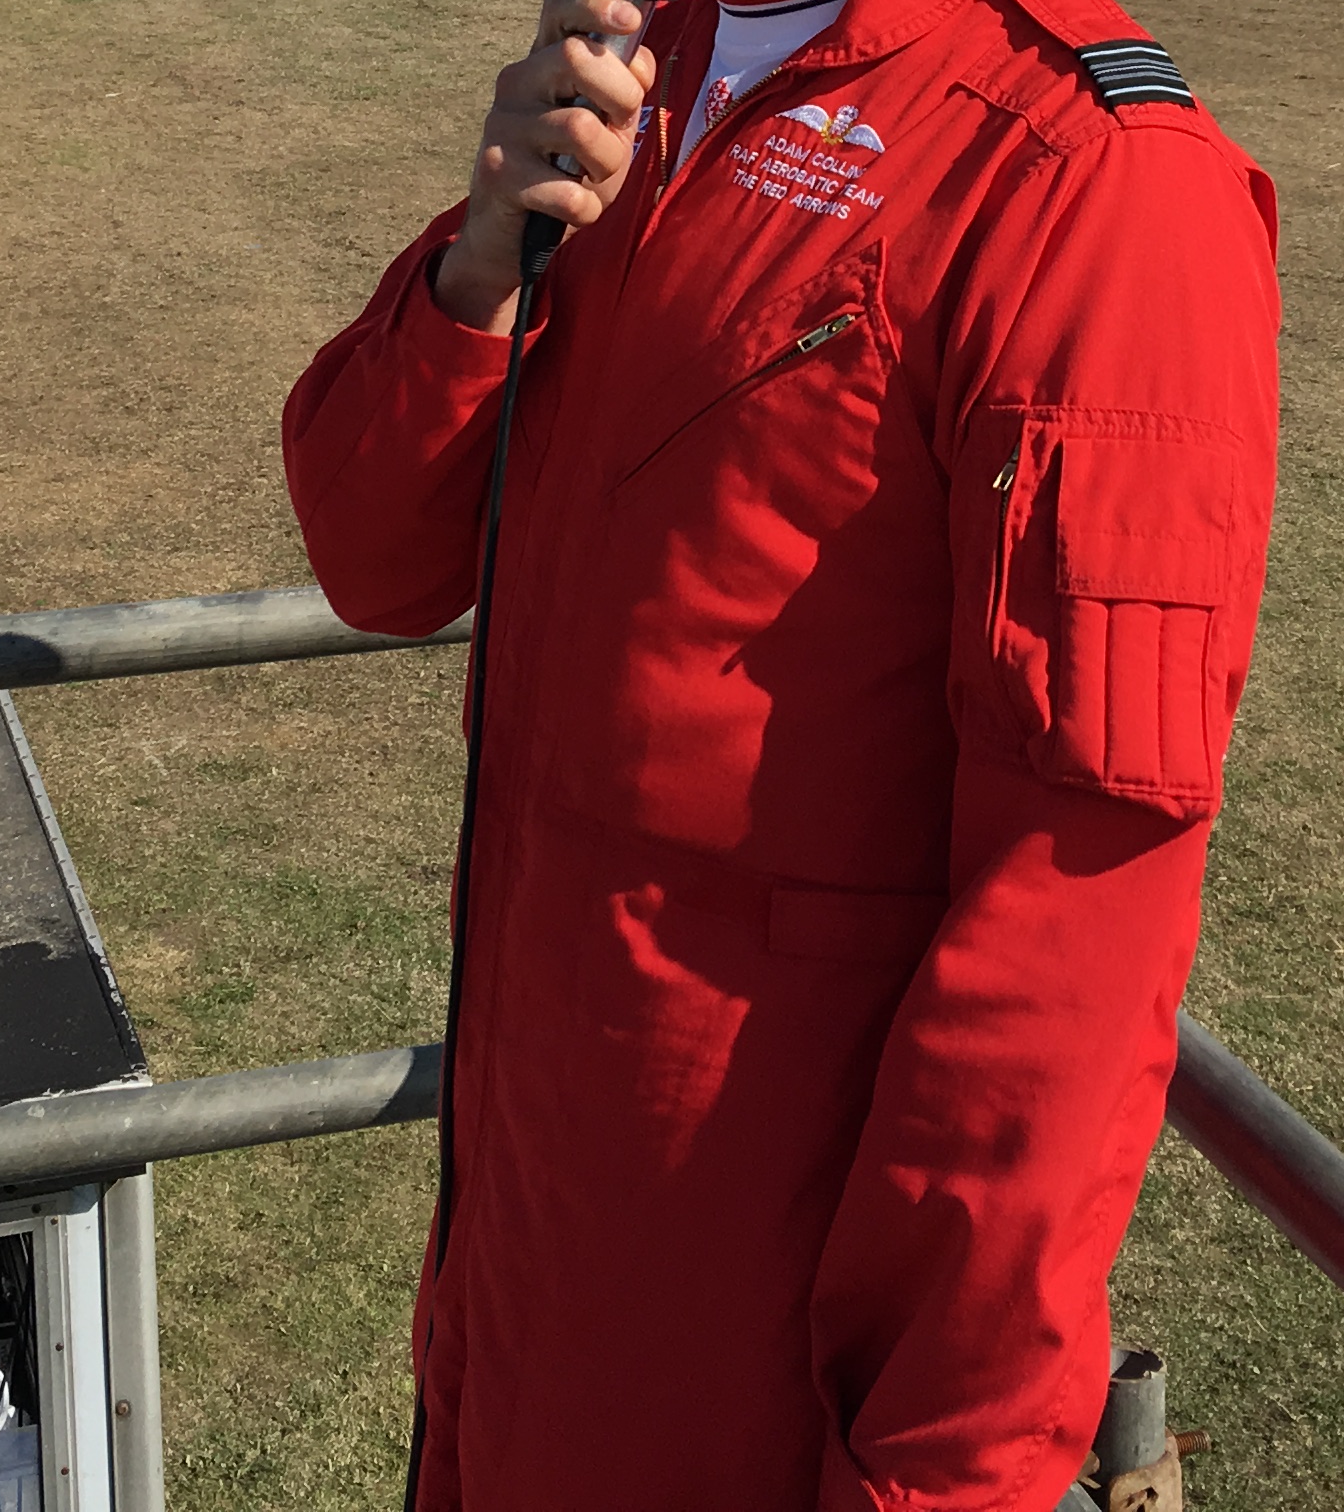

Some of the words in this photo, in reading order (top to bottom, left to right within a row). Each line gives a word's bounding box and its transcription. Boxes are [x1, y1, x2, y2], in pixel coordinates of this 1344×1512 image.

[729, 143, 759, 165] RAF
[759, 157, 839, 194] AEROBATIC
[764, 134, 812, 163] ADAM
[732, 168, 759, 190] THE
[759, 179, 788, 200] RED
[789, 192, 852, 220] ARROWS
